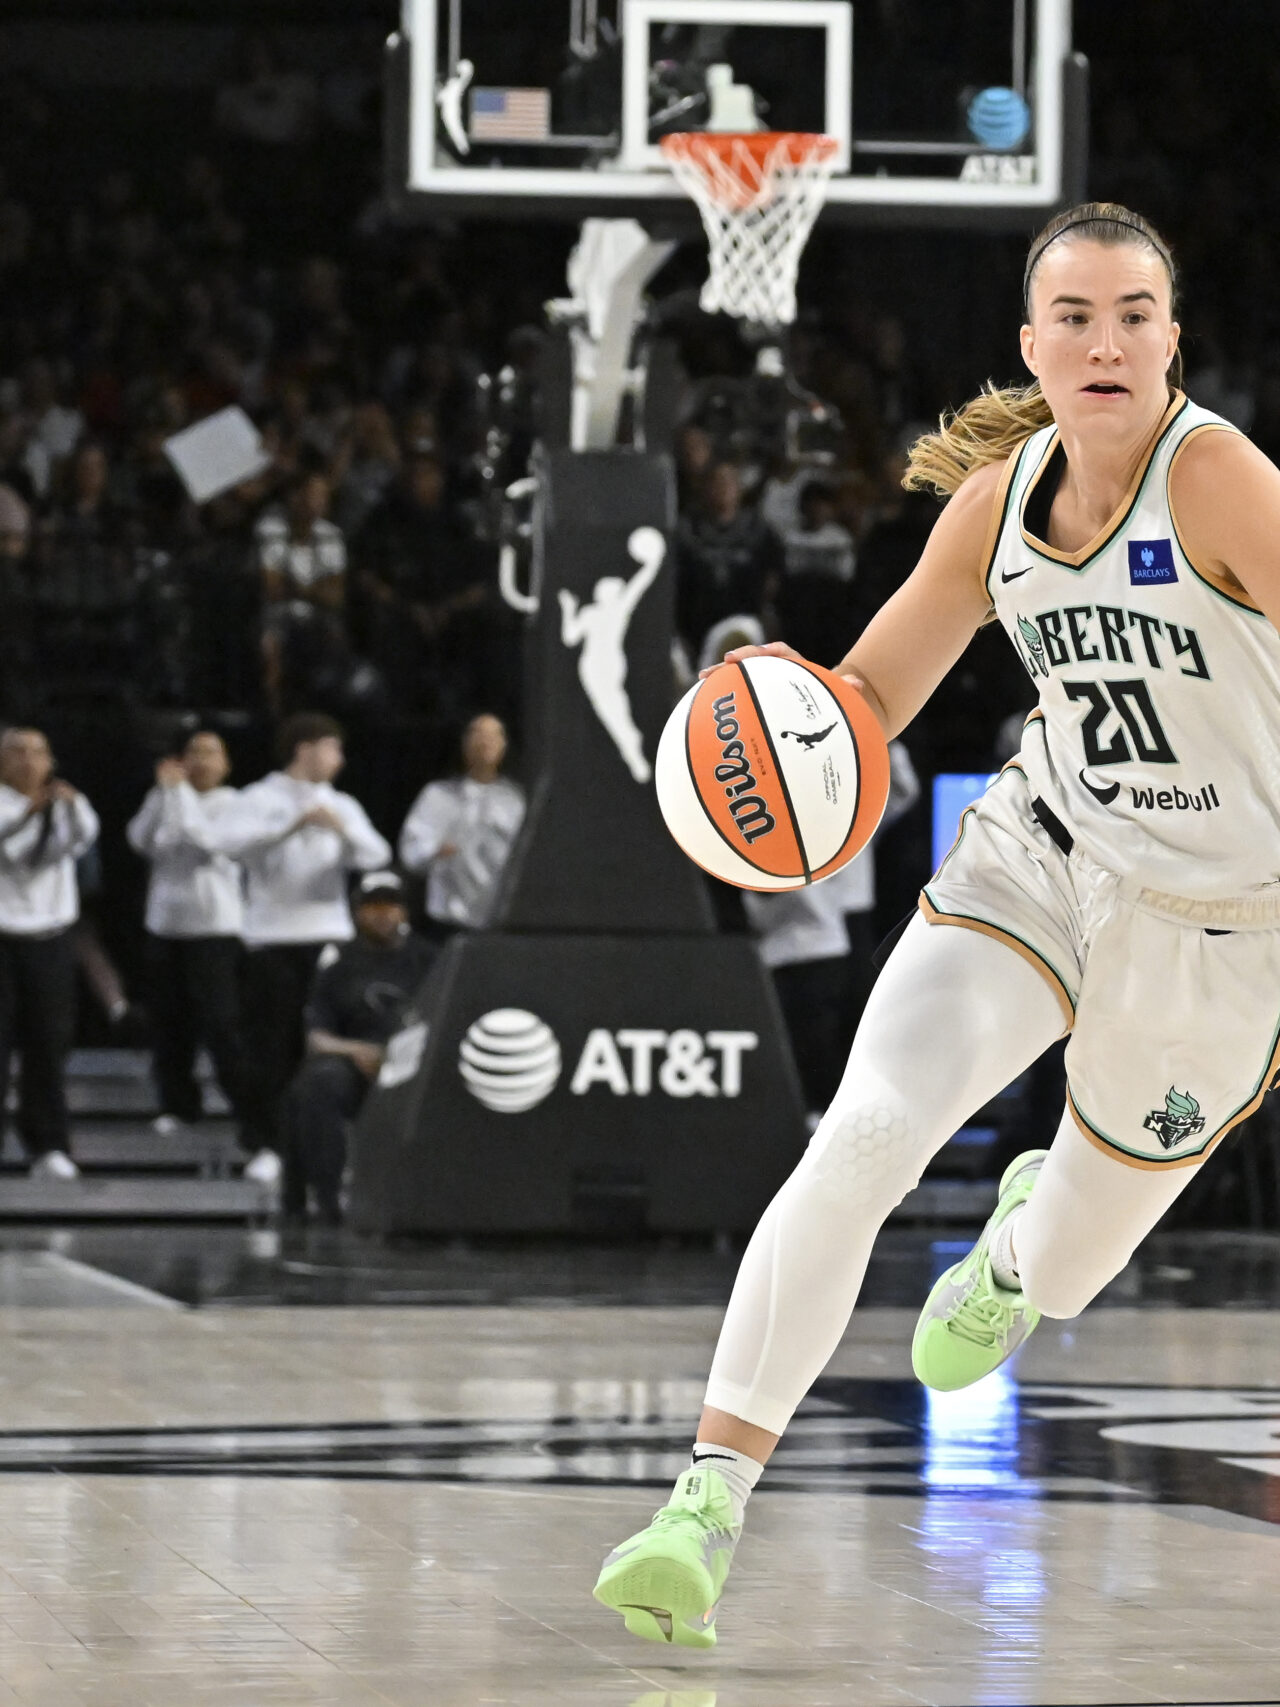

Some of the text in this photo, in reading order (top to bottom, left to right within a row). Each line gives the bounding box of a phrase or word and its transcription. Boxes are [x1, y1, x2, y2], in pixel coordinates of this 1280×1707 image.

[1133, 567, 1170, 578] BARCLAYS
[1061, 677, 1180, 767] 20
[711, 691, 776, 846] Wilson
[1129, 782, 1221, 812] Webull
[569, 1028, 759, 1097] AT&T
